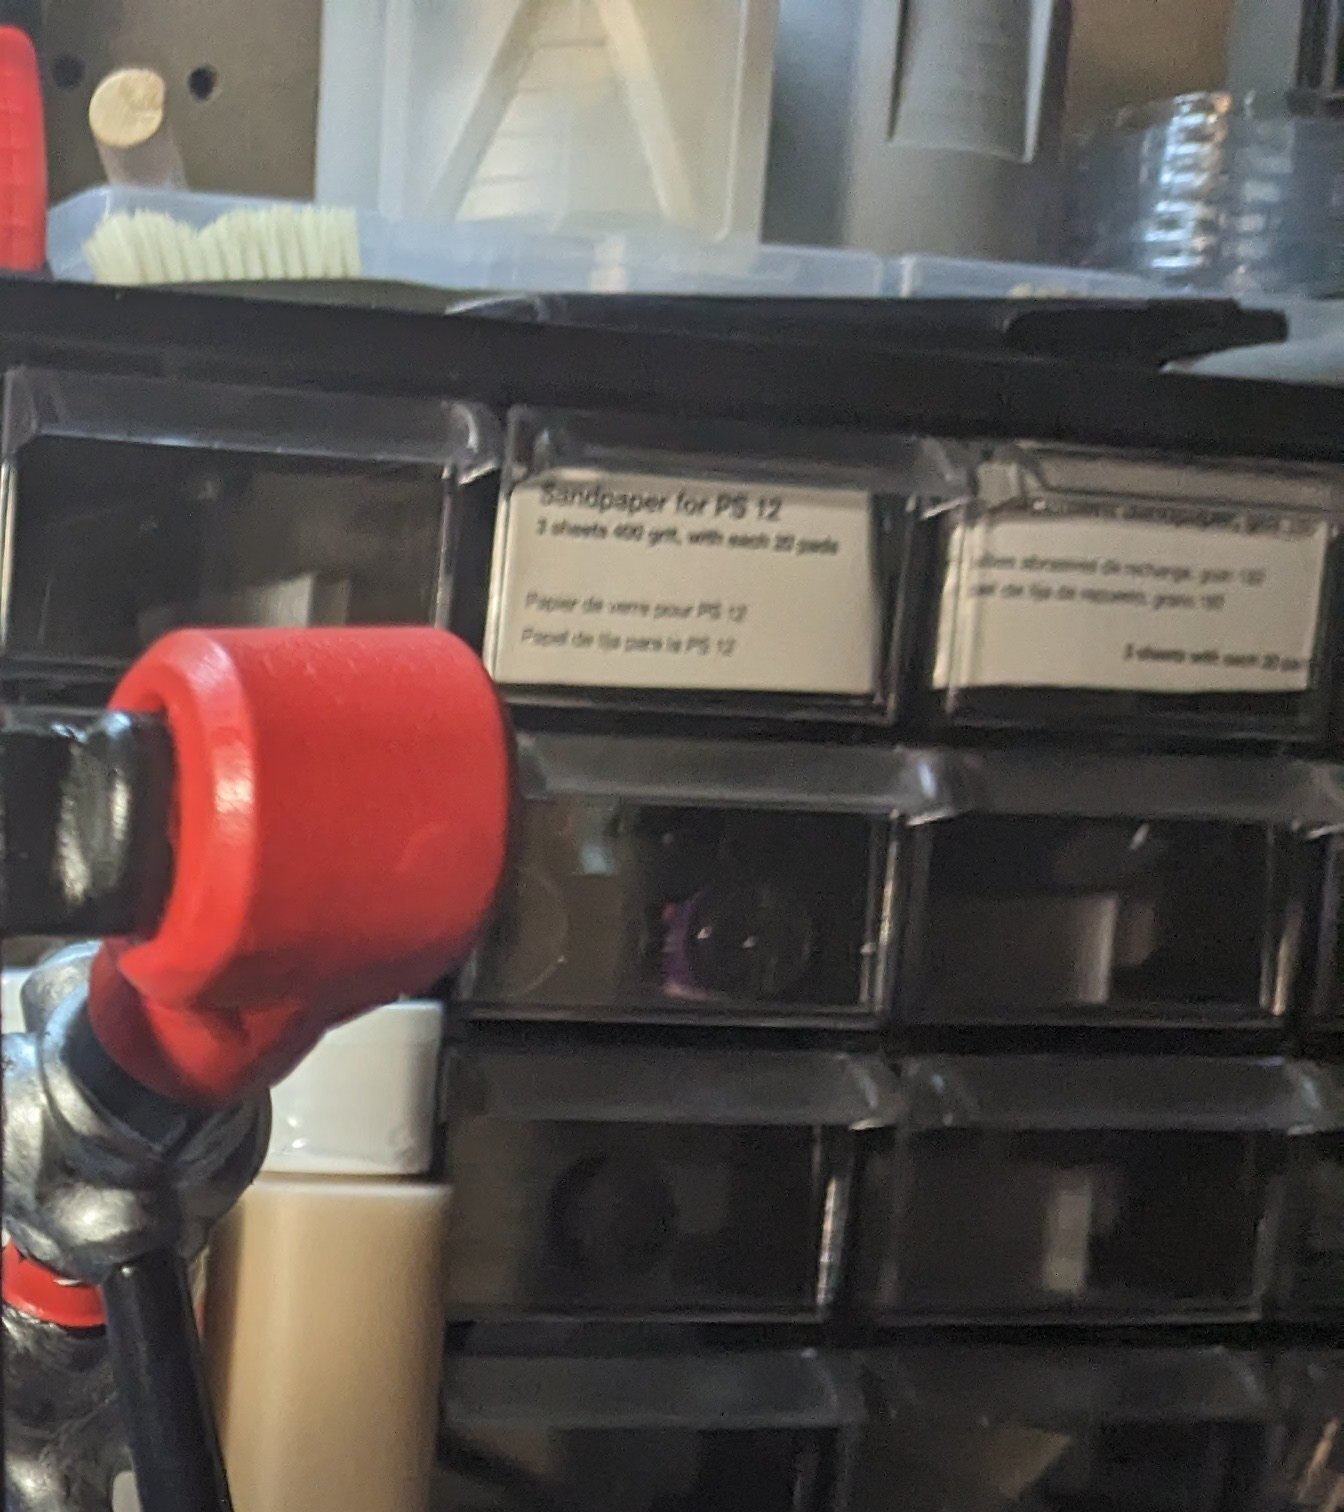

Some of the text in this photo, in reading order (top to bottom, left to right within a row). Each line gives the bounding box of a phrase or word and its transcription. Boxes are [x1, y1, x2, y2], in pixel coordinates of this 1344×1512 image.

[541, 479, 781, 521] Sandpaper for PS 12
[687, 528, 723, 545] with
[728, 532, 770, 549] each
[581, 595, 603, 613] de
[571, 630, 594, 647] de
